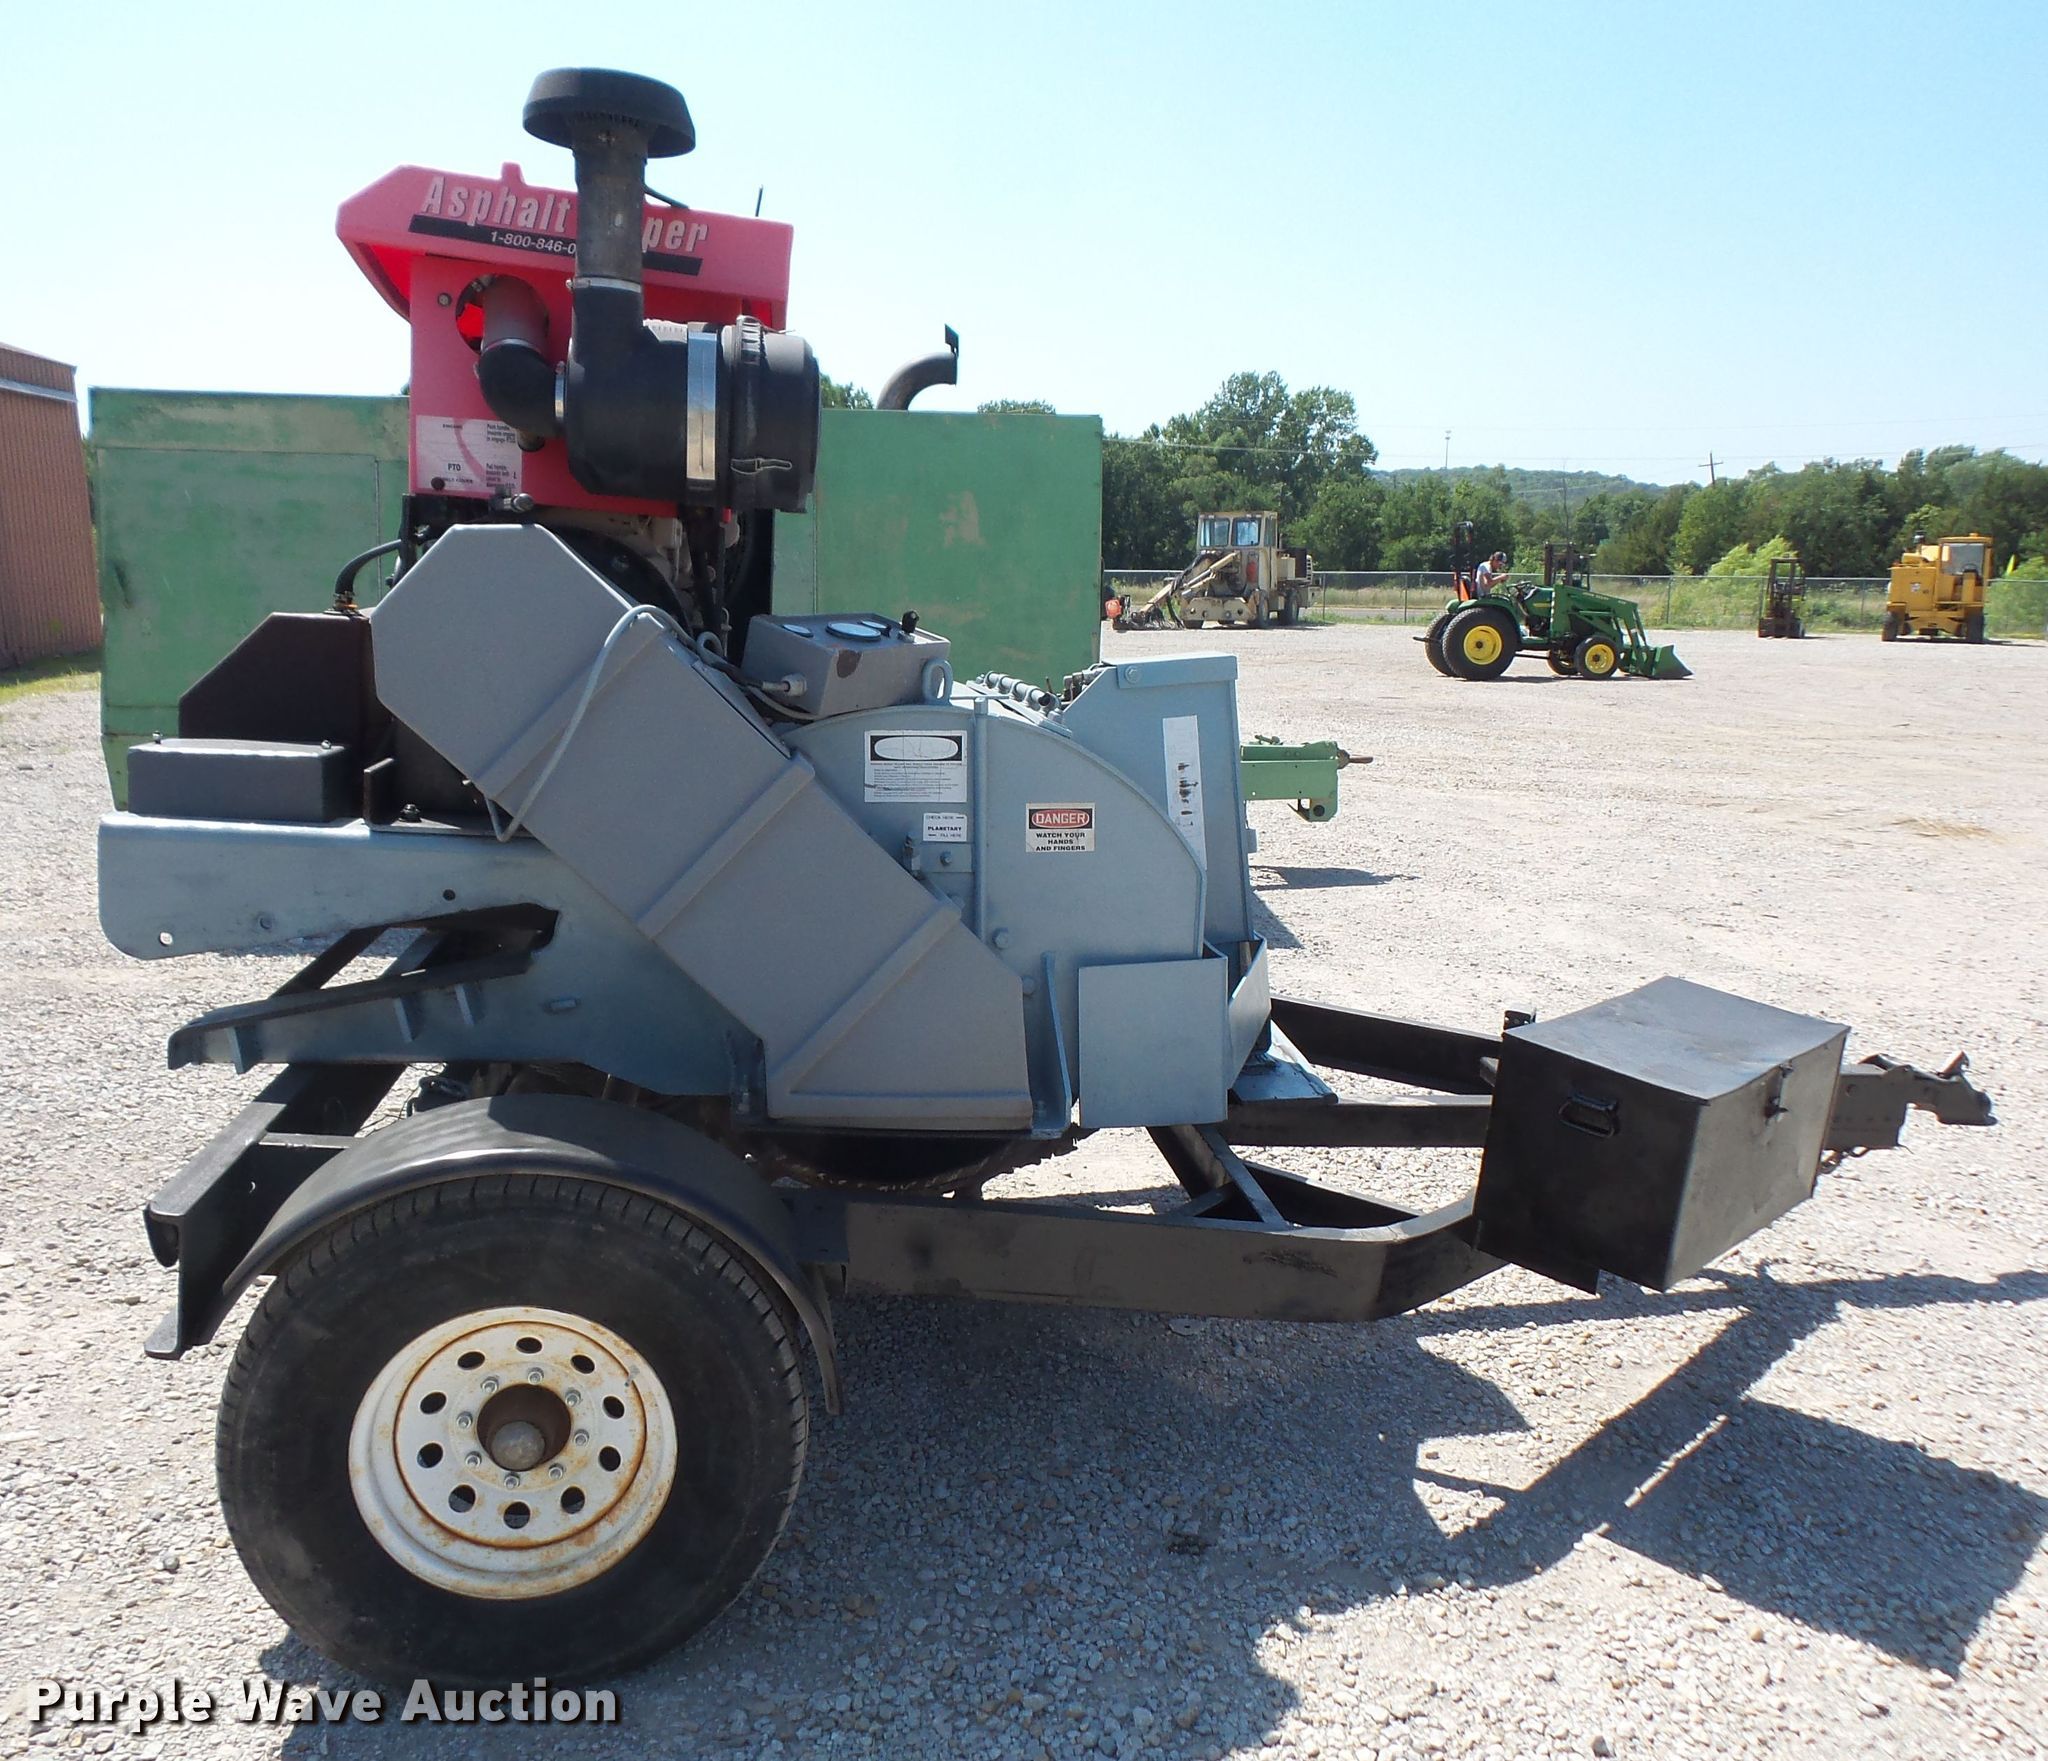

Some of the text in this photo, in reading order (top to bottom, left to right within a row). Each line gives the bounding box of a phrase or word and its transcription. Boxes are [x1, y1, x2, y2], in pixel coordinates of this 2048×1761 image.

[421, 175, 709, 253] Asphalt per
[490, 230, 577, 256] 1-800-846-0
[447, 463, 462, 471] PTO
[1036, 812, 1086, 824] DANGER
